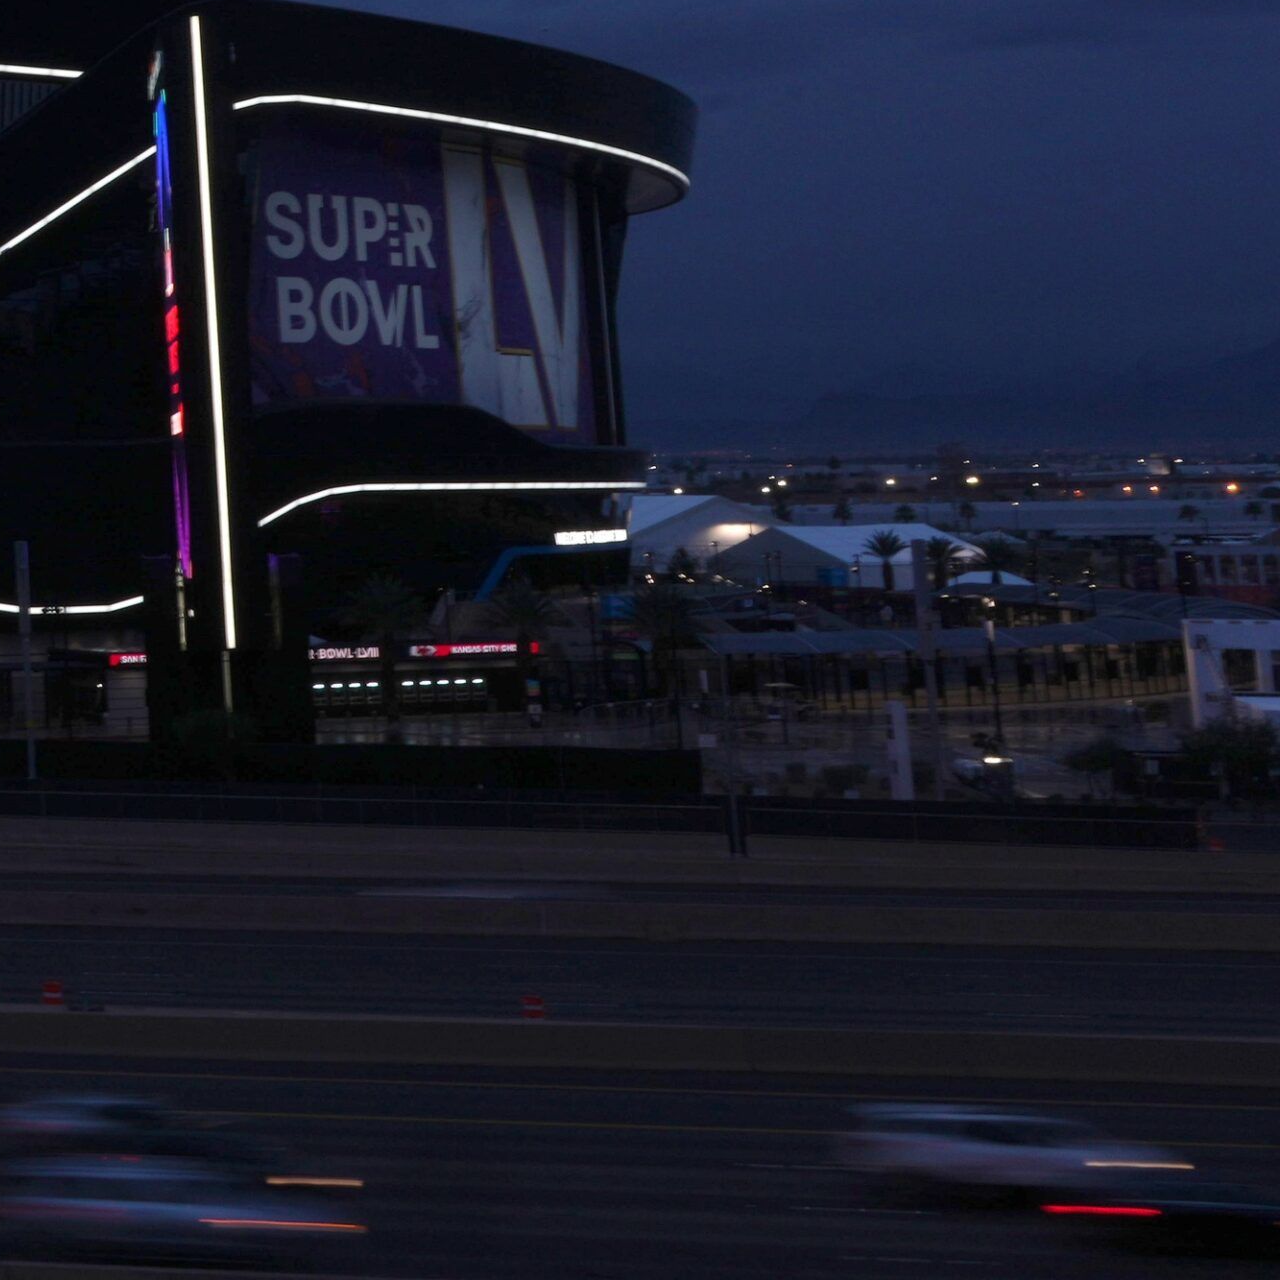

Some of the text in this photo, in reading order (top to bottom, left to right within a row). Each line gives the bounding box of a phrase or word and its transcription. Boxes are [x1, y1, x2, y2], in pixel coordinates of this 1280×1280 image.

[264, 190, 438, 269] SUPER
[275, 275, 440, 350] BOWL
[482, 644, 500, 653] CITY
